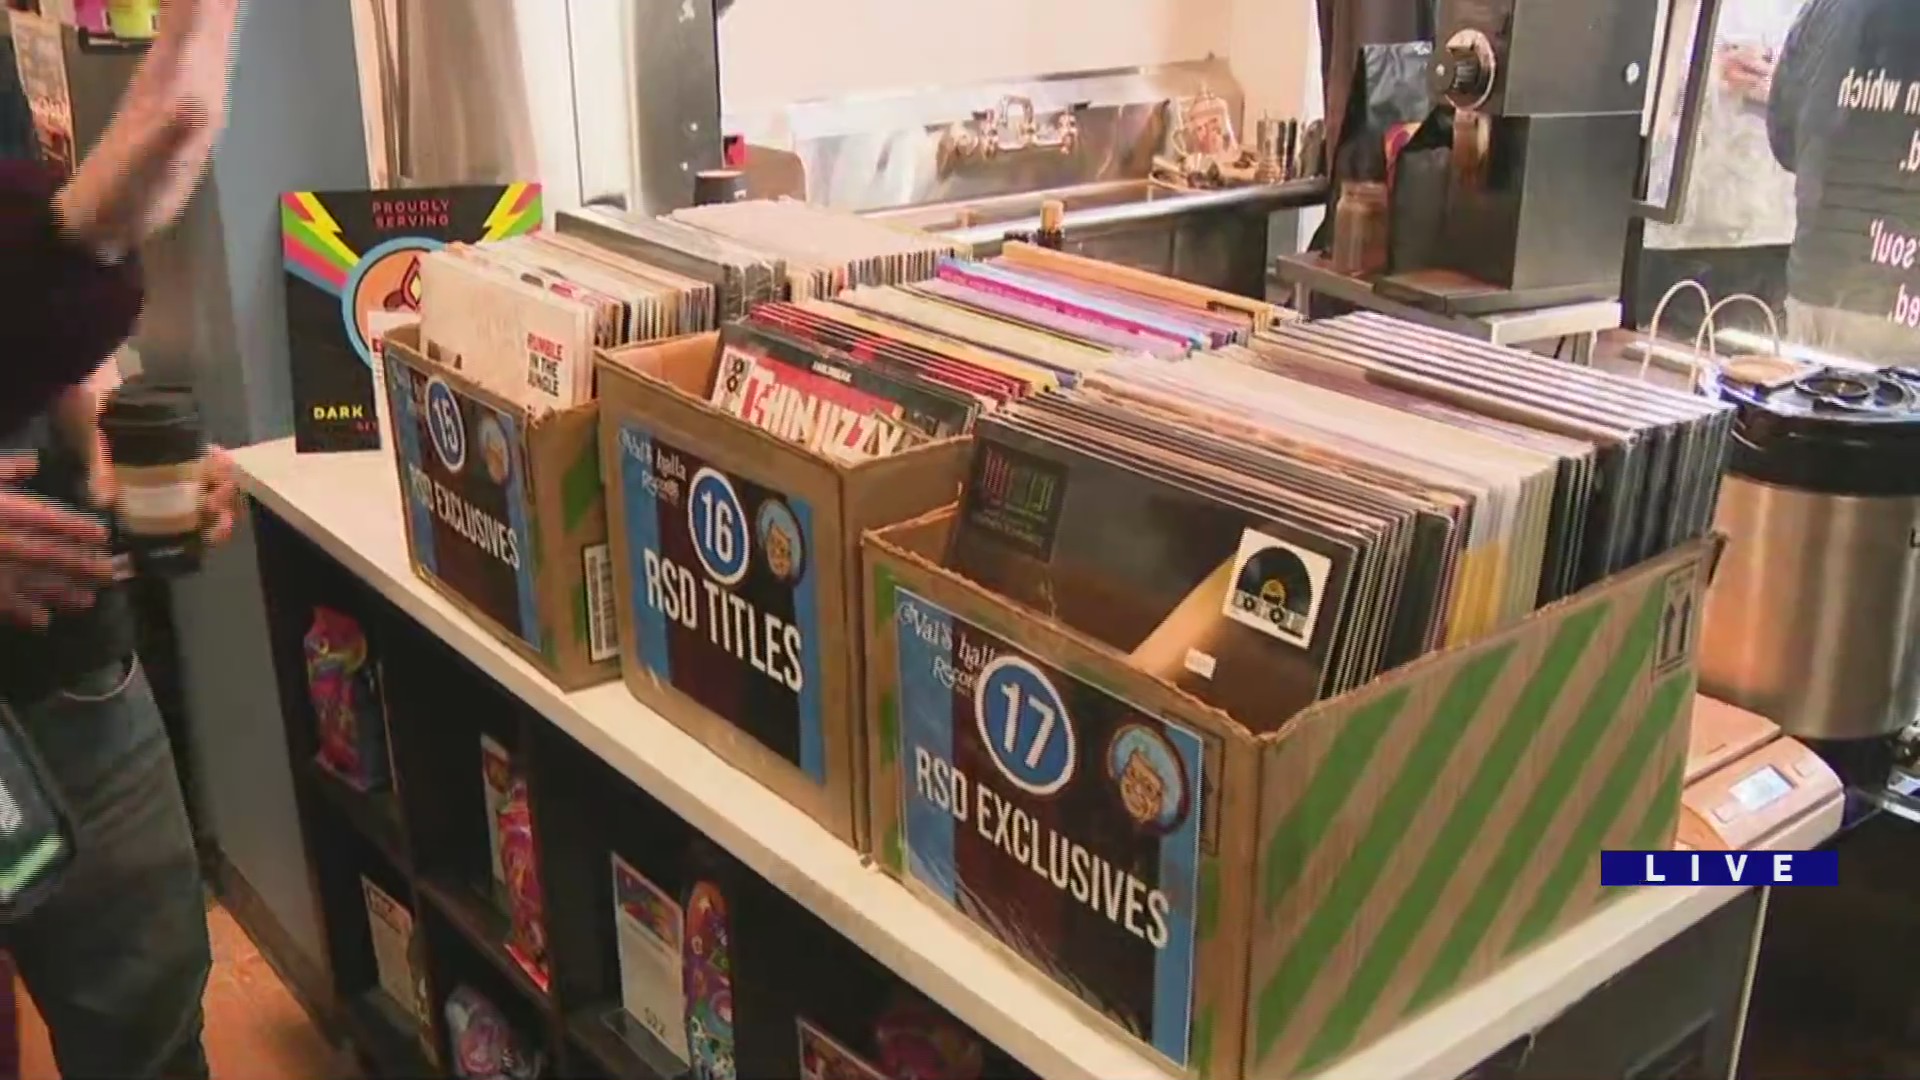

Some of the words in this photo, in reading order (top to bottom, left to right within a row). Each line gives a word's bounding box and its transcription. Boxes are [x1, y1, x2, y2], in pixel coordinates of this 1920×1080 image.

[372, 200, 450, 213] PROUDLY
[376, 214, 449, 229] SERVING
[527, 332, 562, 361] RUMBLE
[528, 352, 539, 370] IN
[541, 356, 558, 378] THE
[527, 370, 560, 397] JUNGLE
[313, 404, 363, 420] DARK
[433, 397, 459, 450] 15
[434, 479, 520, 571] EXCLUSIVES
[701, 490, 733, 563] 16
[644, 548, 697, 630] RSD
[703, 579, 803, 692] TITLES
[959, 631, 995, 672] hall
[1001, 682, 1055, 768] 17
[915, 746, 969, 822] RSD
[976, 783, 1169, 949] EXCLUSIVES
